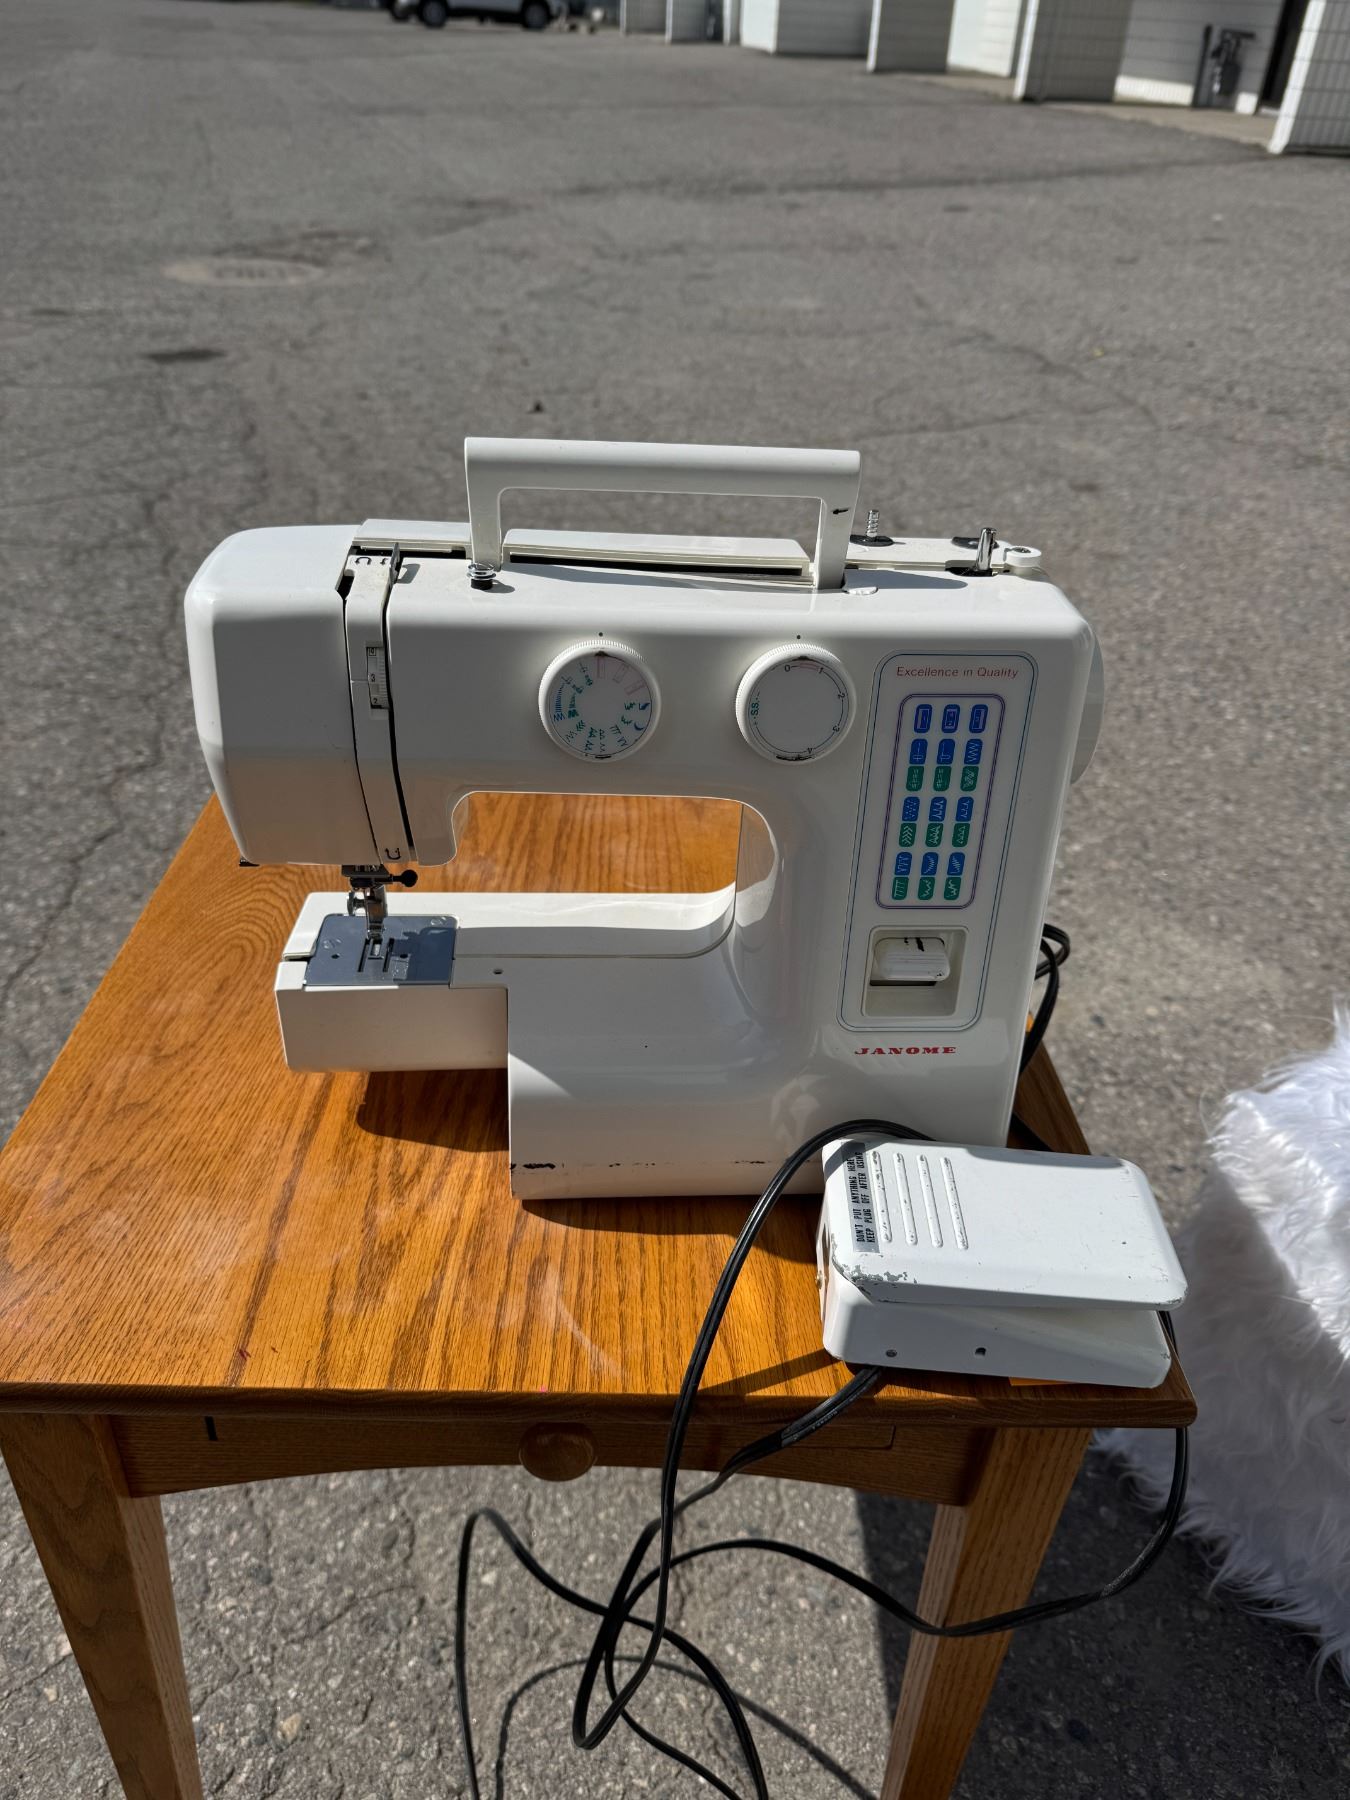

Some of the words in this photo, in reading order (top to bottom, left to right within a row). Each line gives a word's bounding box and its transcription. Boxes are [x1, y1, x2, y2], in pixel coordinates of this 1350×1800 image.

[784, 664, 791, 673] 0
[896, 665, 959, 678] Excellence
[963, 667, 973, 677] in
[977, 666, 1019, 680] Quality
[854, 1046, 957, 1055] JANOME
[854, 1151, 865, 1169] USING
[858, 1172, 868, 1190] AFTER
[849, 1176, 860, 1204] ANYTHING
[861, 1193, 871, 1204] OFF
[853, 1208, 863, 1220] PUT
[863, 1208, 873, 1224] PLUG
[855, 1224, 865, 1243] DON'T
[865, 1228, 876, 1243] KEEP
